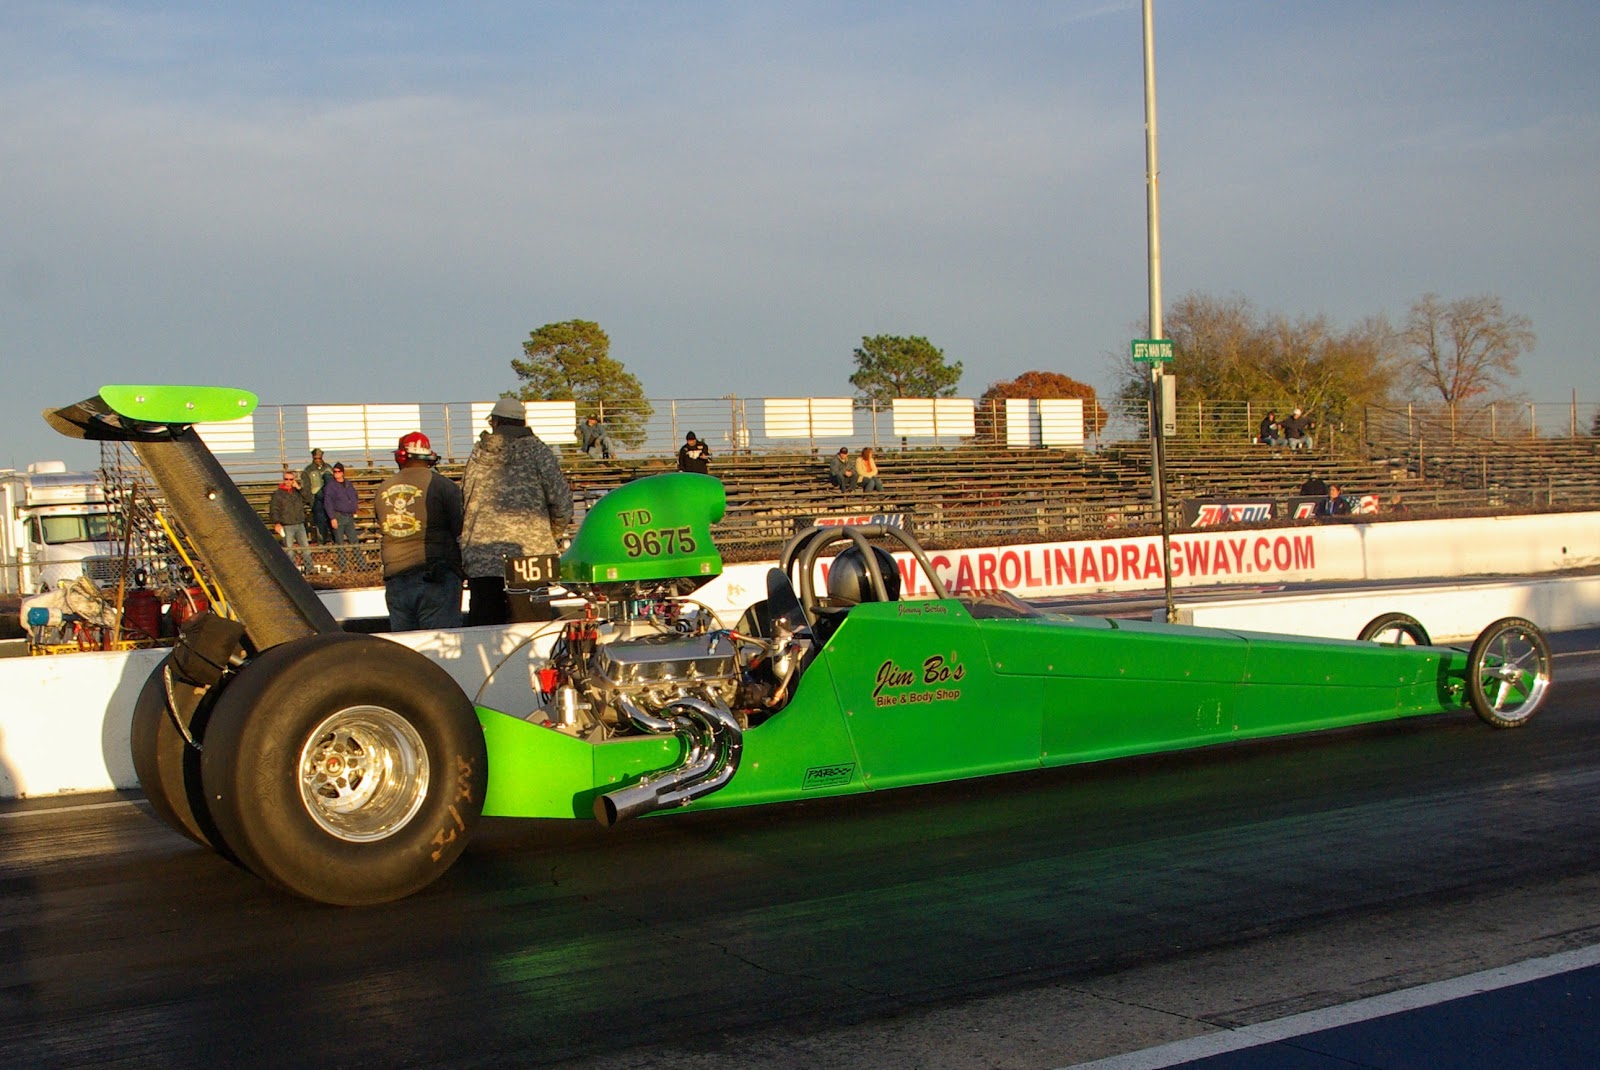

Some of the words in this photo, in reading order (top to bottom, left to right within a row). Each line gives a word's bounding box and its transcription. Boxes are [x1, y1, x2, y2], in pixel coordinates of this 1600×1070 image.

[618, 510, 651, 528] T/D
[1192, 503, 1271, 528] AMSOIL
[623, 526, 697, 558] 9675
[873, 660, 914, 698] Jim
[924, 650, 965, 683] Bo's
[876, 696, 898, 707] Bike
[900, 694, 907, 704] &
[909, 691, 934, 703] Body
[936, 689, 961, 700] Shop
